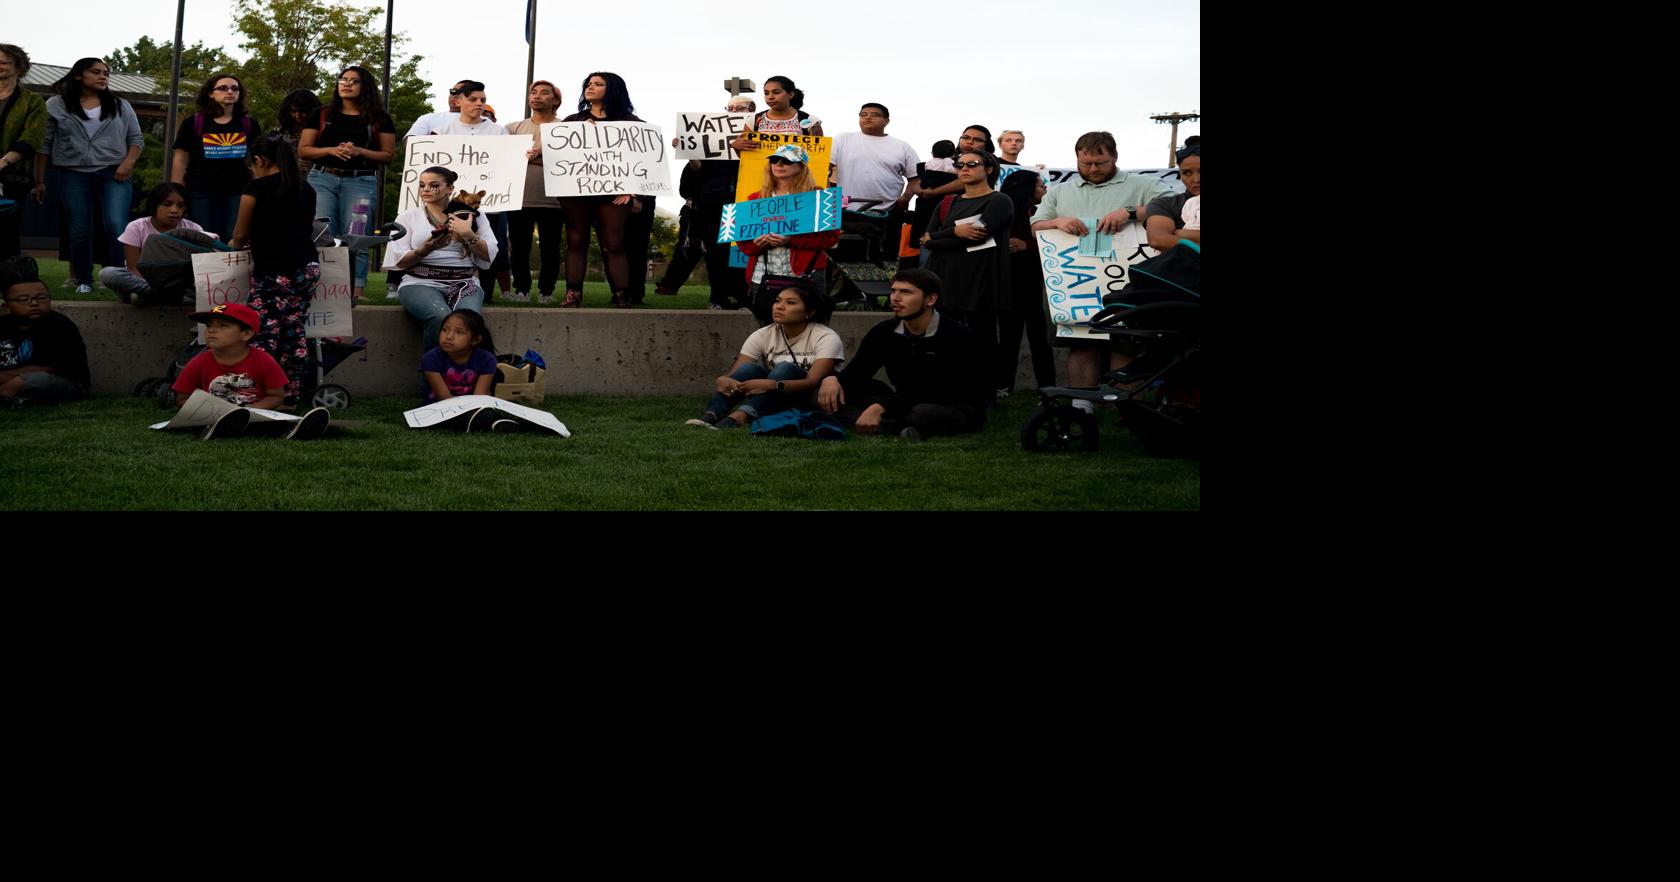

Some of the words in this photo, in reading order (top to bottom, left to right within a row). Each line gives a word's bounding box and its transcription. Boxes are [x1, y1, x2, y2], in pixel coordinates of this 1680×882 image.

[682, 114, 744, 133] WATE
[547, 123, 664, 162] SOLIDARITY
[680, 136, 697, 150] is
[702, 134, 738, 159] LIF
[747, 132, 820, 144] PROTECT
[409, 140, 452, 166] END
[458, 143, 489, 166] the
[584, 151, 622, 162] WITH
[800, 143, 826, 154] ARTH
[550, 160, 648, 179] STANDING
[576, 177, 624, 194] ROCK
[750, 195, 805, 217] PEOPLE
[1058, 245, 1104, 326] WATE
